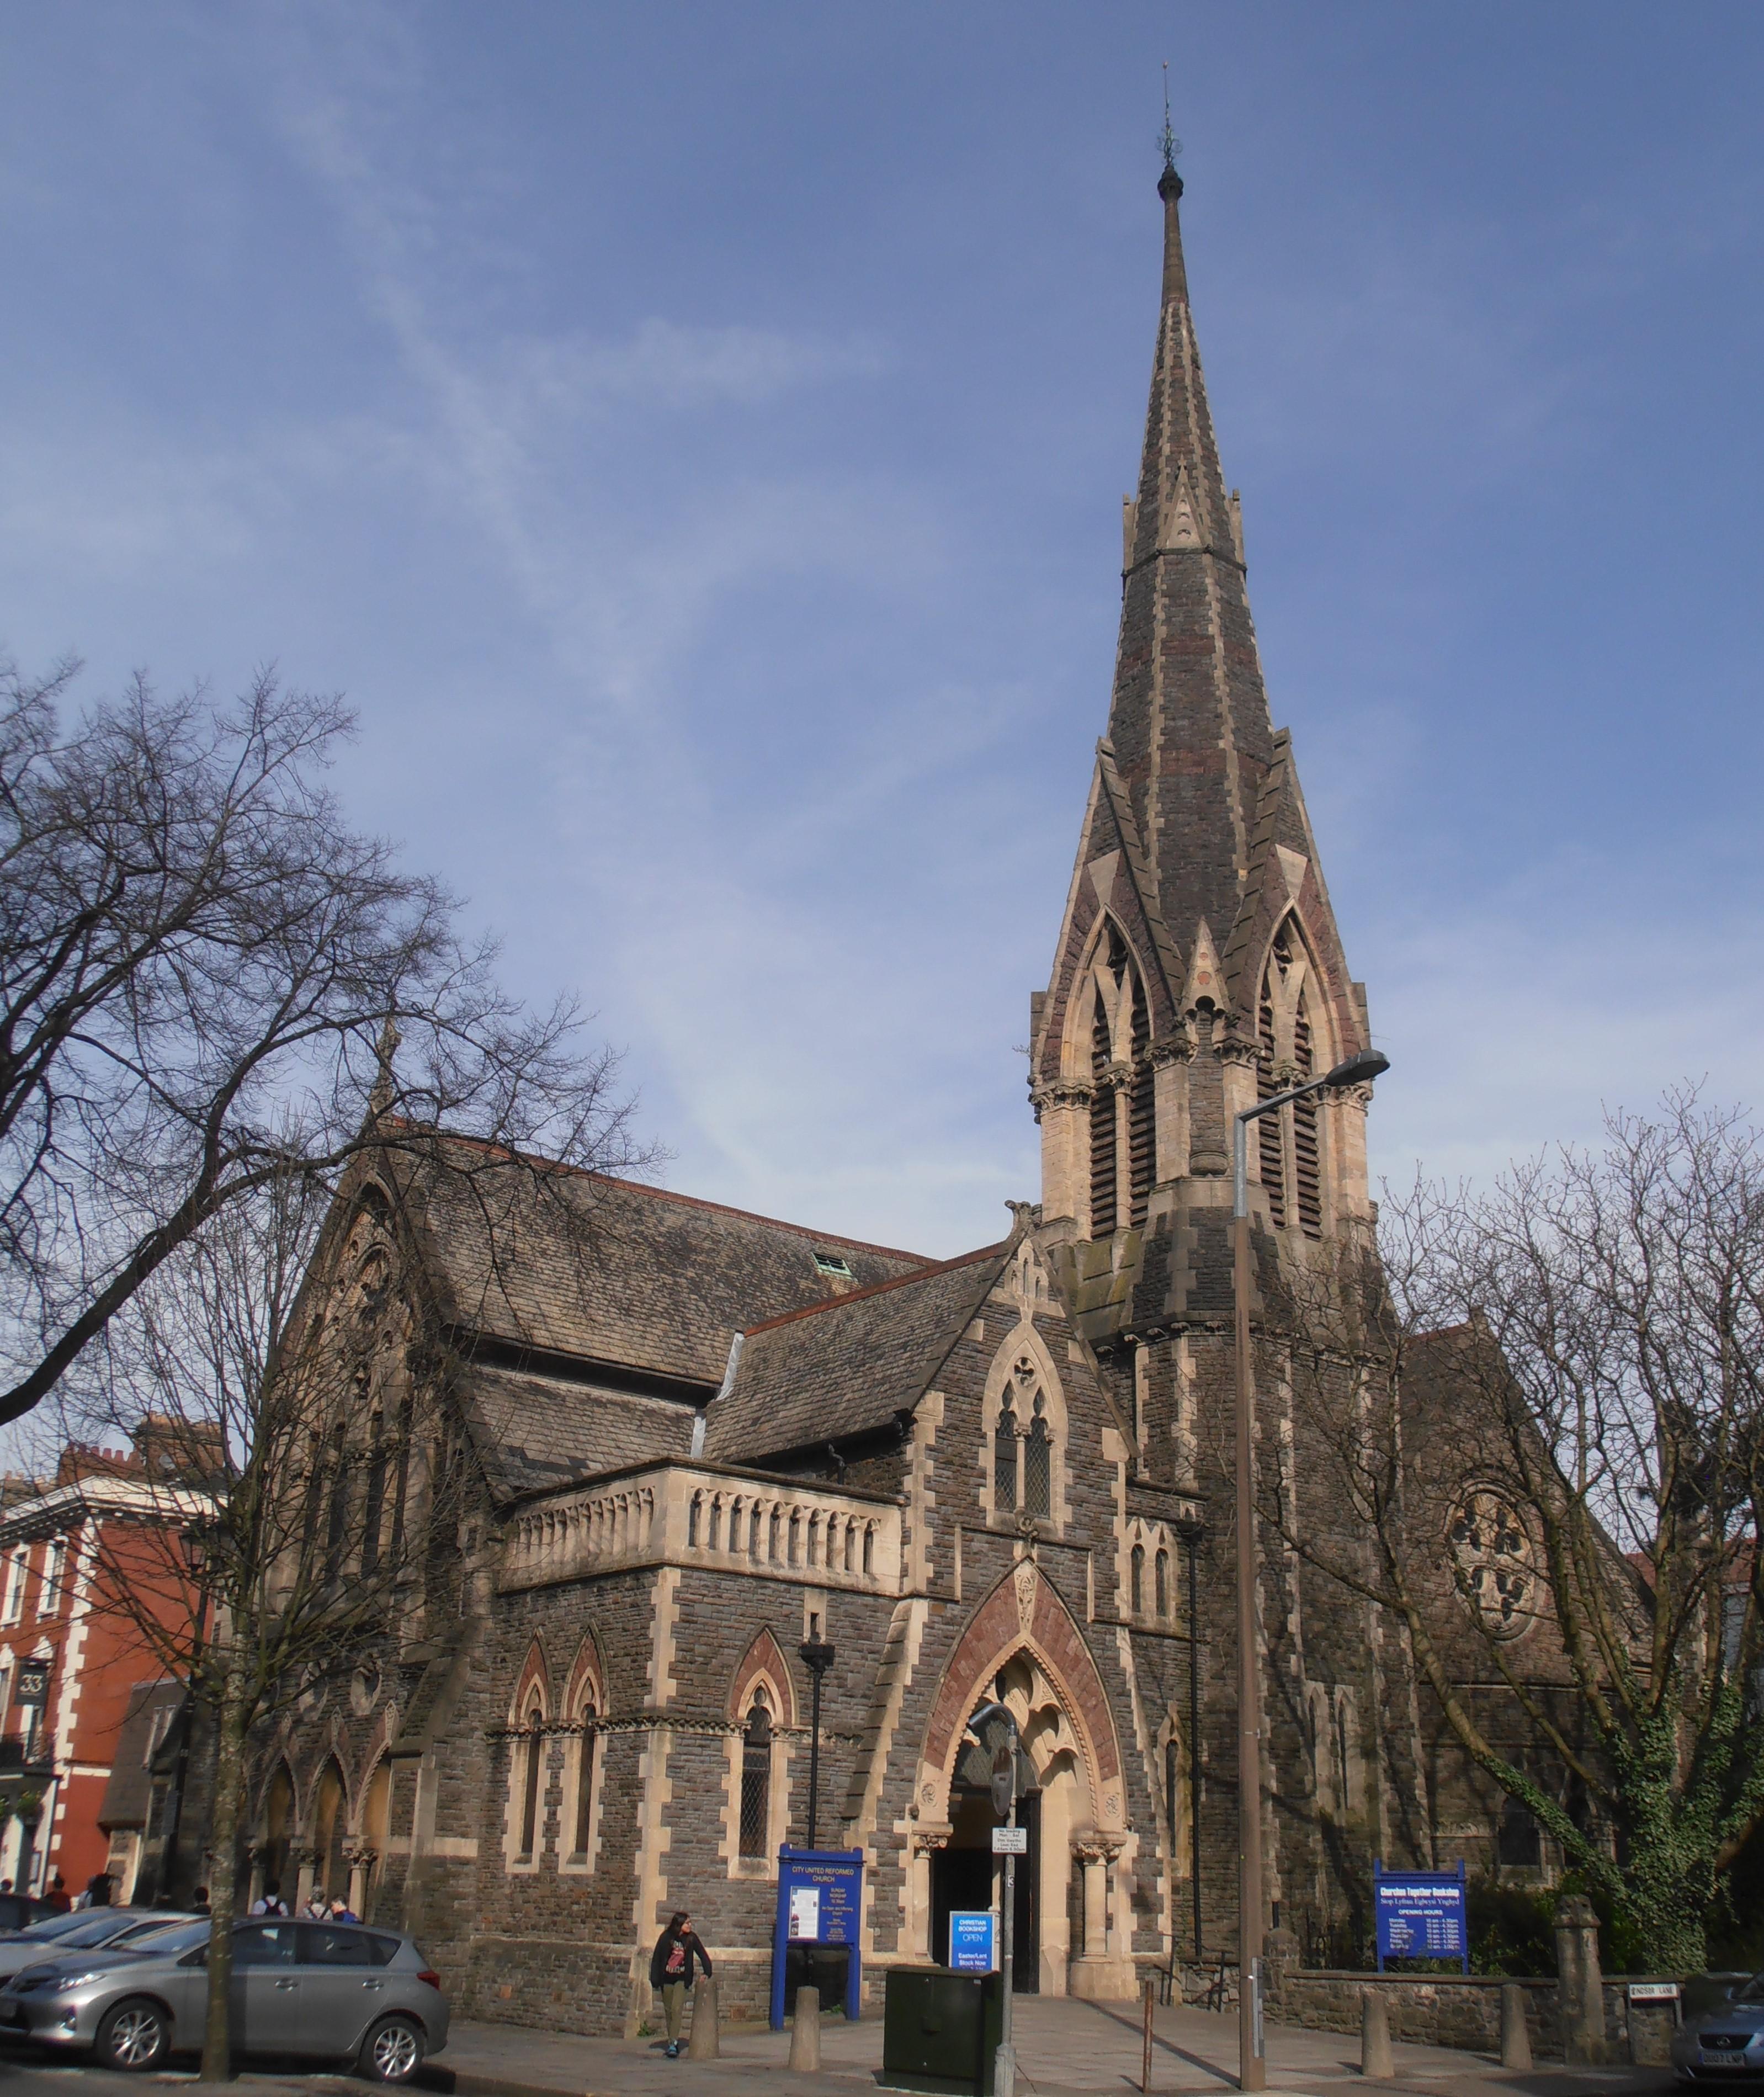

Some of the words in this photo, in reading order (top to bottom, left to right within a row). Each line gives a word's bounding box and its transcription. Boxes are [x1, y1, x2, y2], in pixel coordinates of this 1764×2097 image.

[19, 1674, 44, 1692] 33
[1009, 1876, 1014, 1886] 3
[963, 1933, 983, 1942] OPEN
